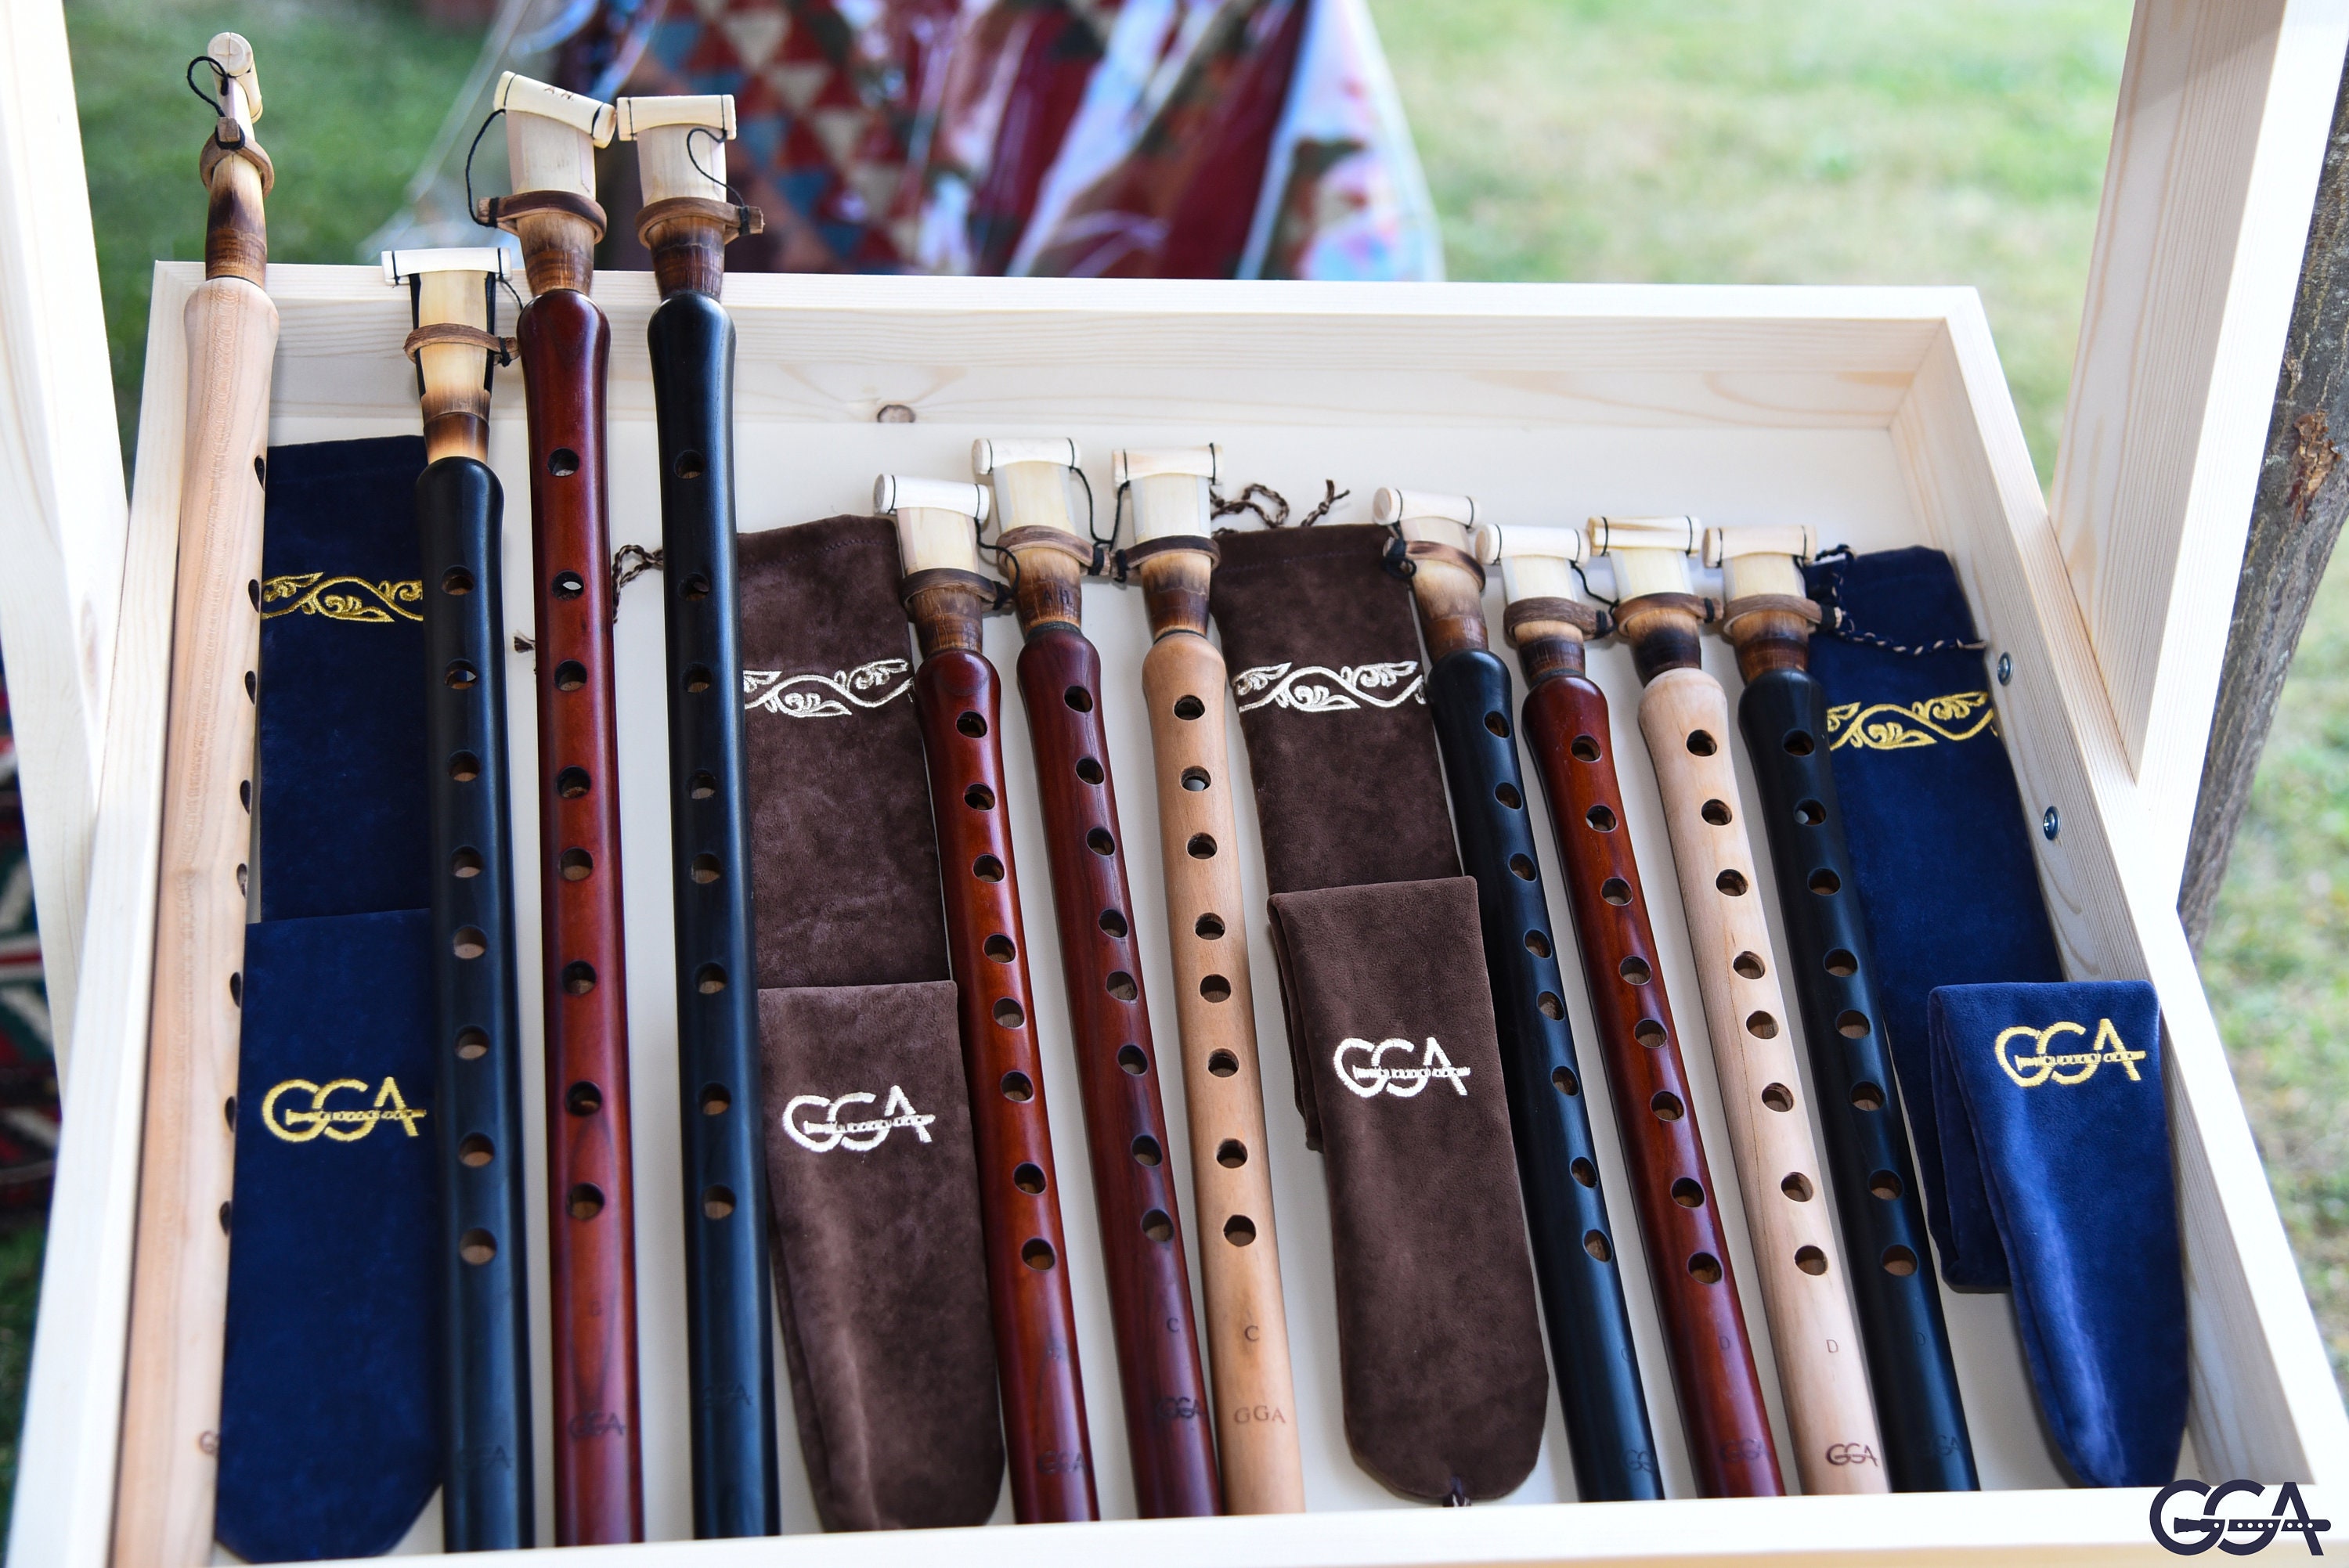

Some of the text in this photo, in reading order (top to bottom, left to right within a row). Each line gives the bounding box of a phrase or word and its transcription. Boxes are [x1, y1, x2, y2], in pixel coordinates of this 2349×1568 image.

[1995, 1018, 2146, 1087] GGA
[1333, 1036, 1470, 1098] GGA
[262, 1076, 427, 1142] GGA
[783, 1085, 936, 1152] GGA
[1166, 1317, 1180, 1332] C
[1244, 1325, 1260, 1342] C
[1719, 1336, 1730, 1350] D
[1826, 1339, 1838, 1353] D
[1233, 1405, 1286, 1424] GGA
[1825, 1443, 1879, 1467] GGA
